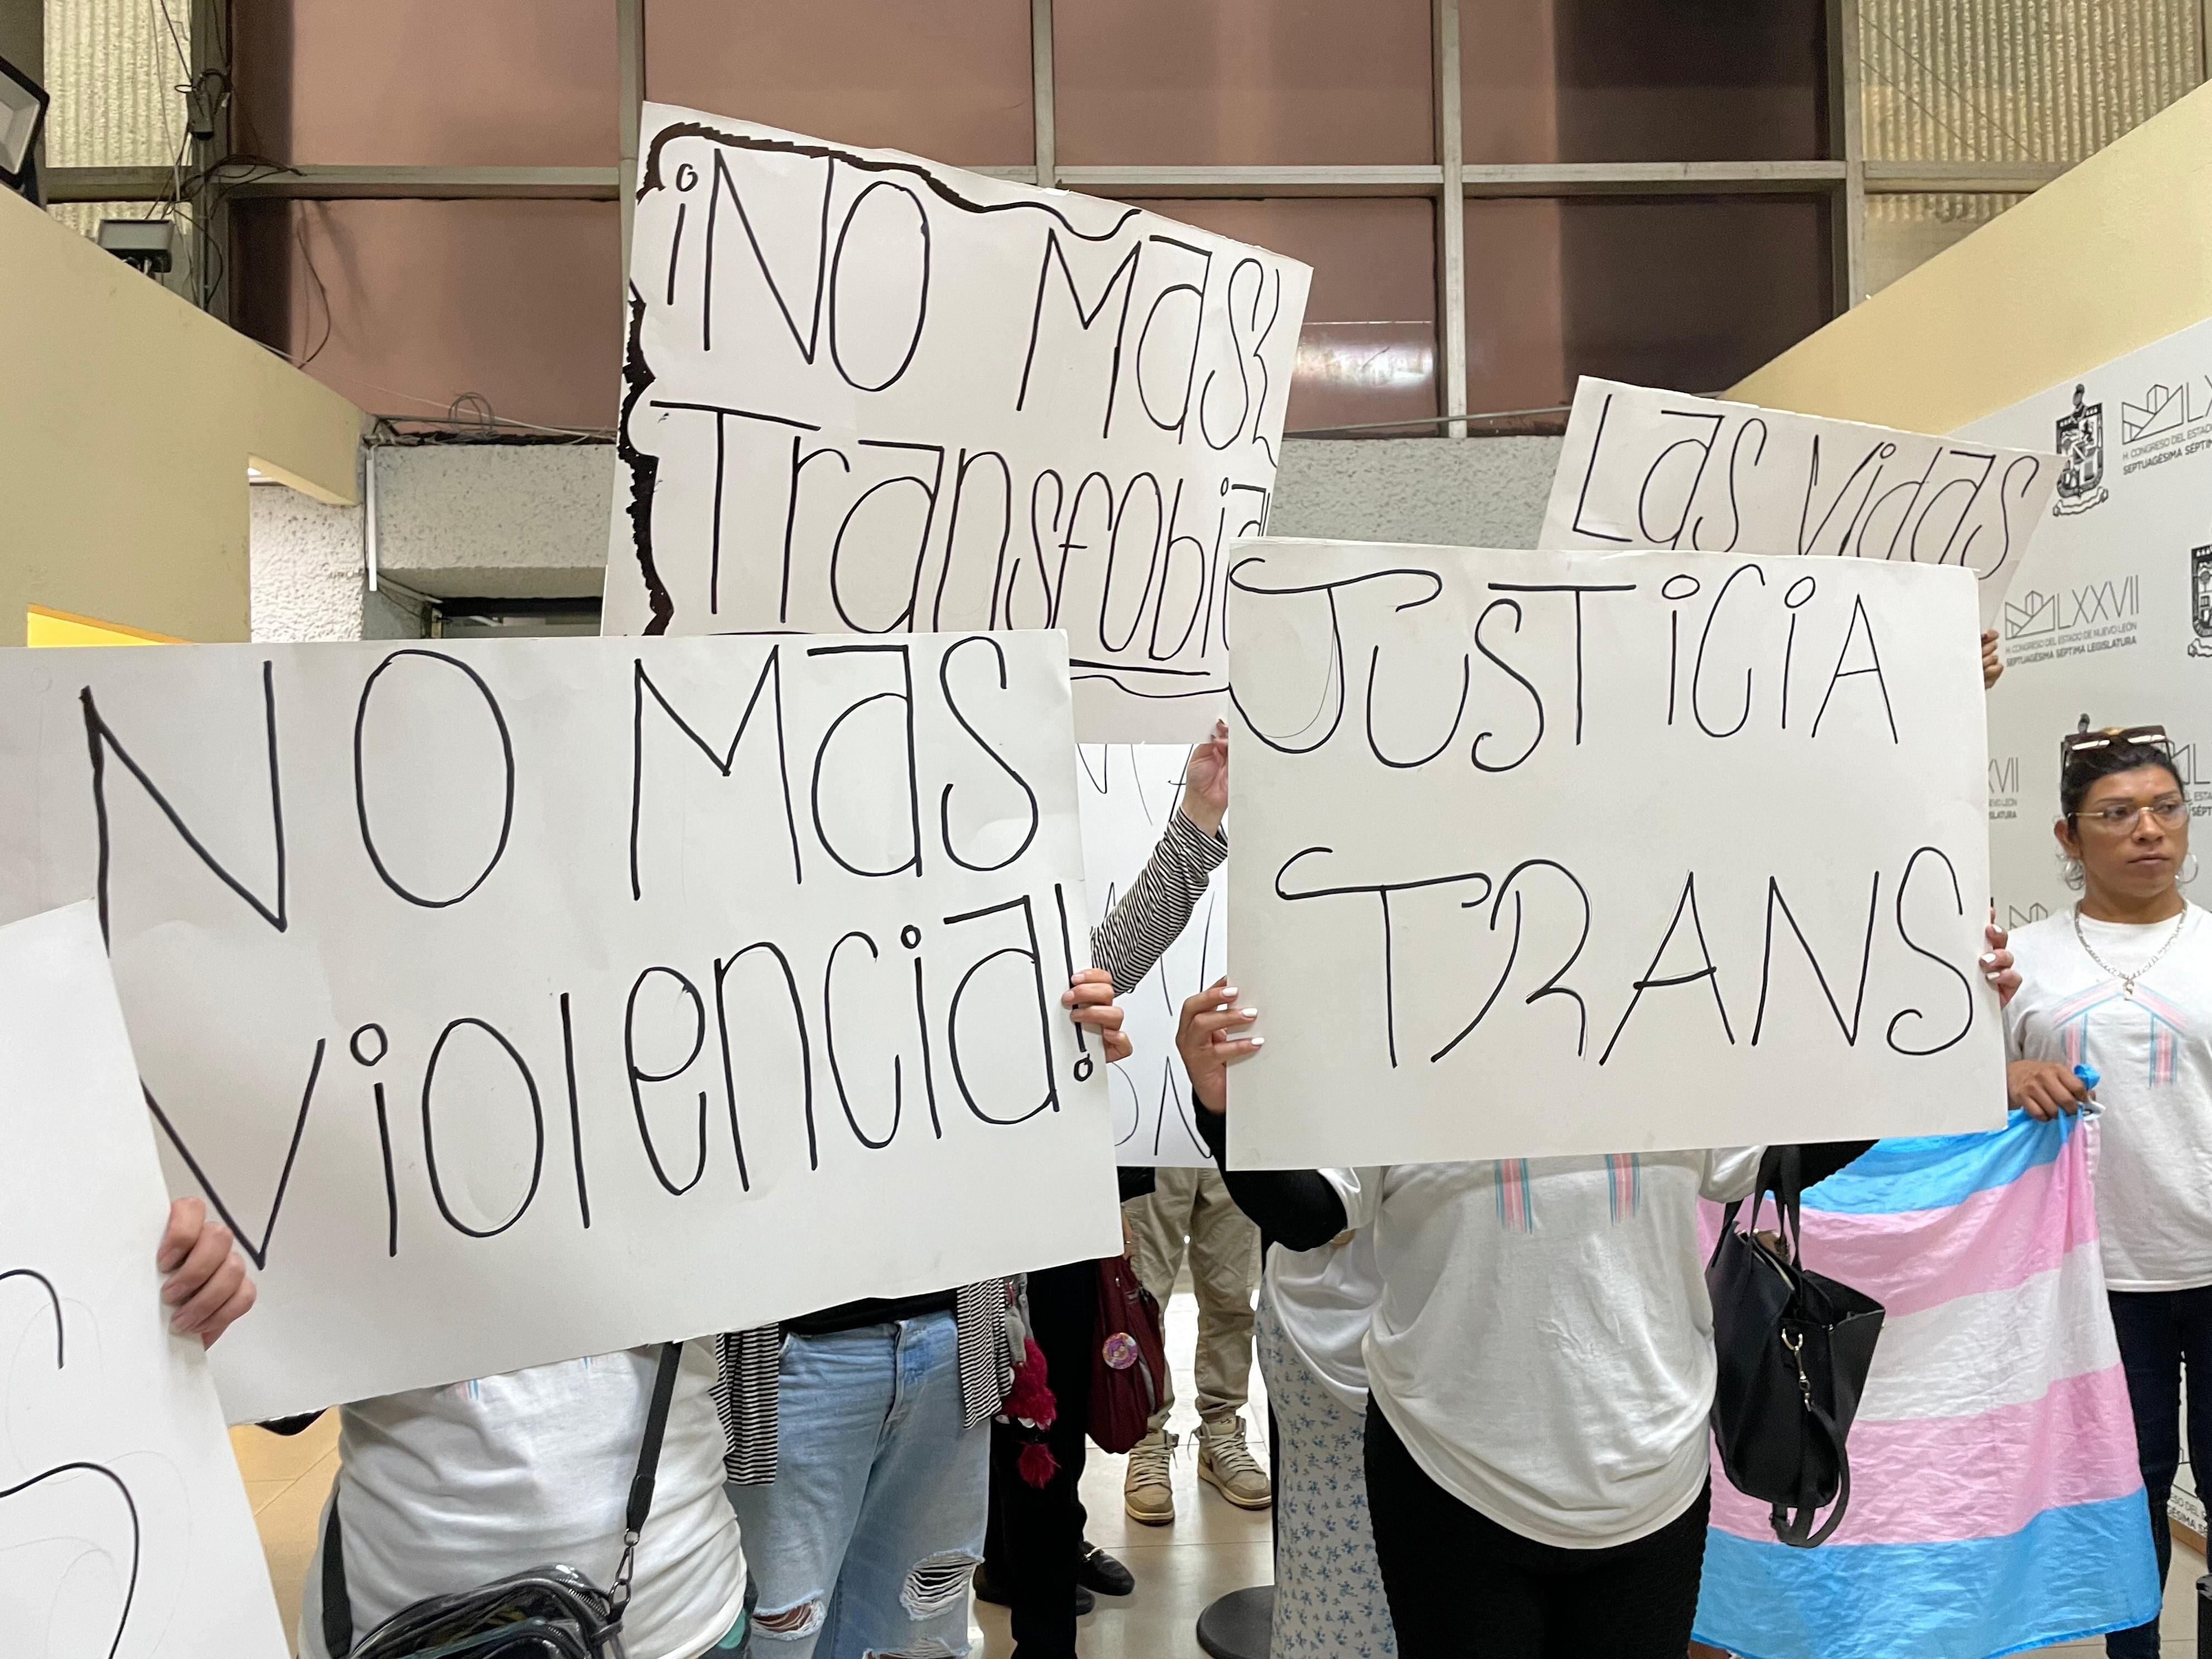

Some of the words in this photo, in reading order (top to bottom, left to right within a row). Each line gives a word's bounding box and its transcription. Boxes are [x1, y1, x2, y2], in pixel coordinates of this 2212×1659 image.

[2057, 575, 2138, 630] LXXVII
[80, 648, 517, 957] NO
[1276, 846, 1973, 1067] TRANS
